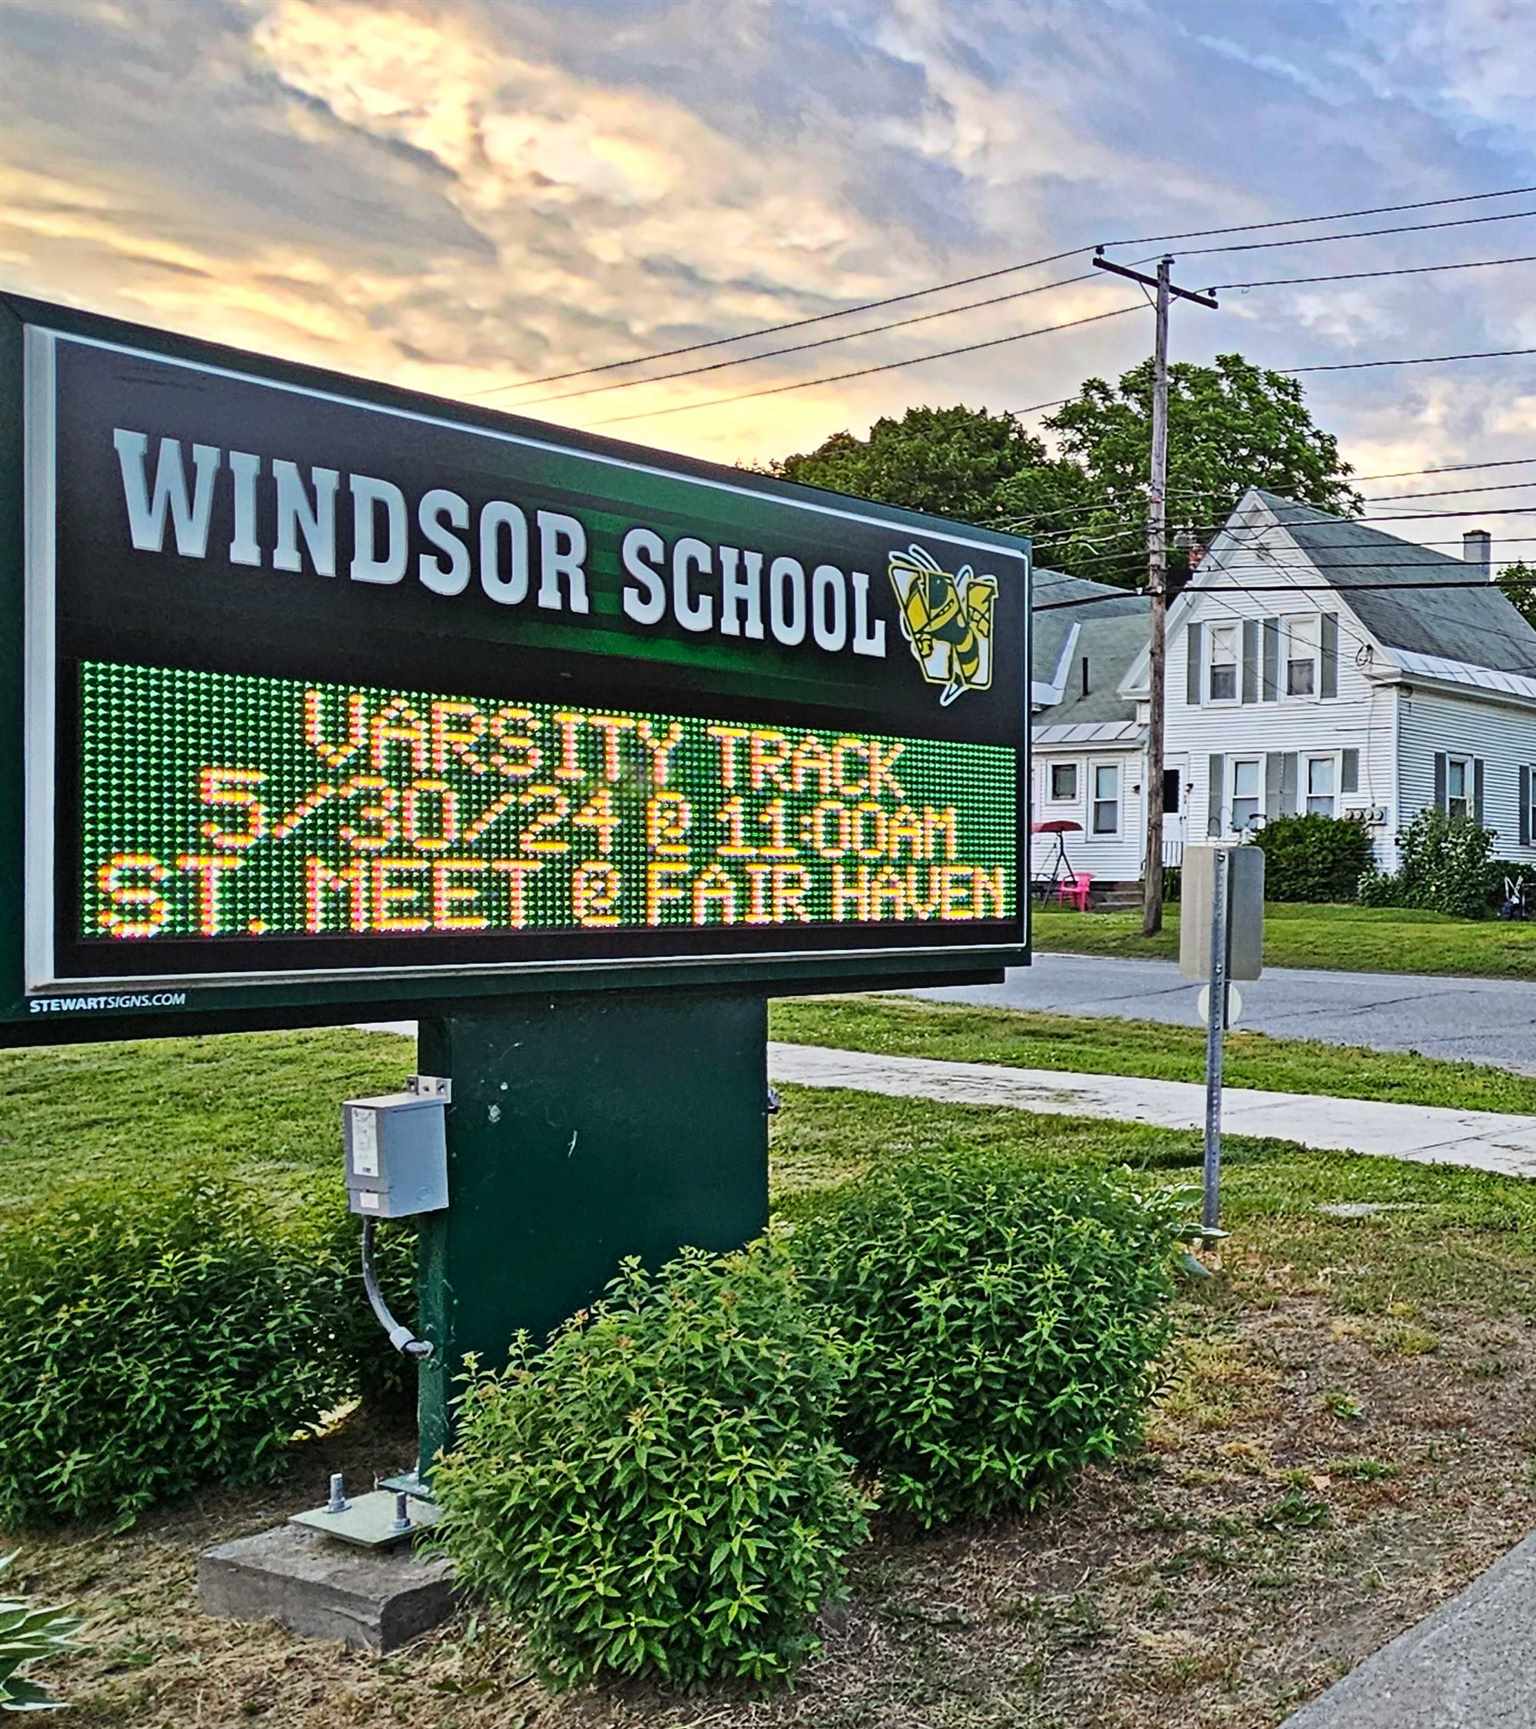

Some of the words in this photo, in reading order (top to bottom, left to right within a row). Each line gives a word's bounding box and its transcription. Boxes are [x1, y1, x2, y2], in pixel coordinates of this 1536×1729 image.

[113, 427, 590, 614] WINDSOR
[621, 527, 887, 658] SCHOOL
[304, 689, 684, 786] VARSITY
[706, 725, 906, 799] TRACK
[198, 765, 622, 855] 5/30/24
[714, 795, 958, 860] 11:00AM
[97, 853, 270, 940] ST.
[304, 854, 546, 933] MEET
[571, 859, 623, 928] @
[646, 861, 812, 927] FAIR
[832, 863, 1008, 922] HAVEN
[29, 992, 187, 1014] STEWARTSIGNS.COM
